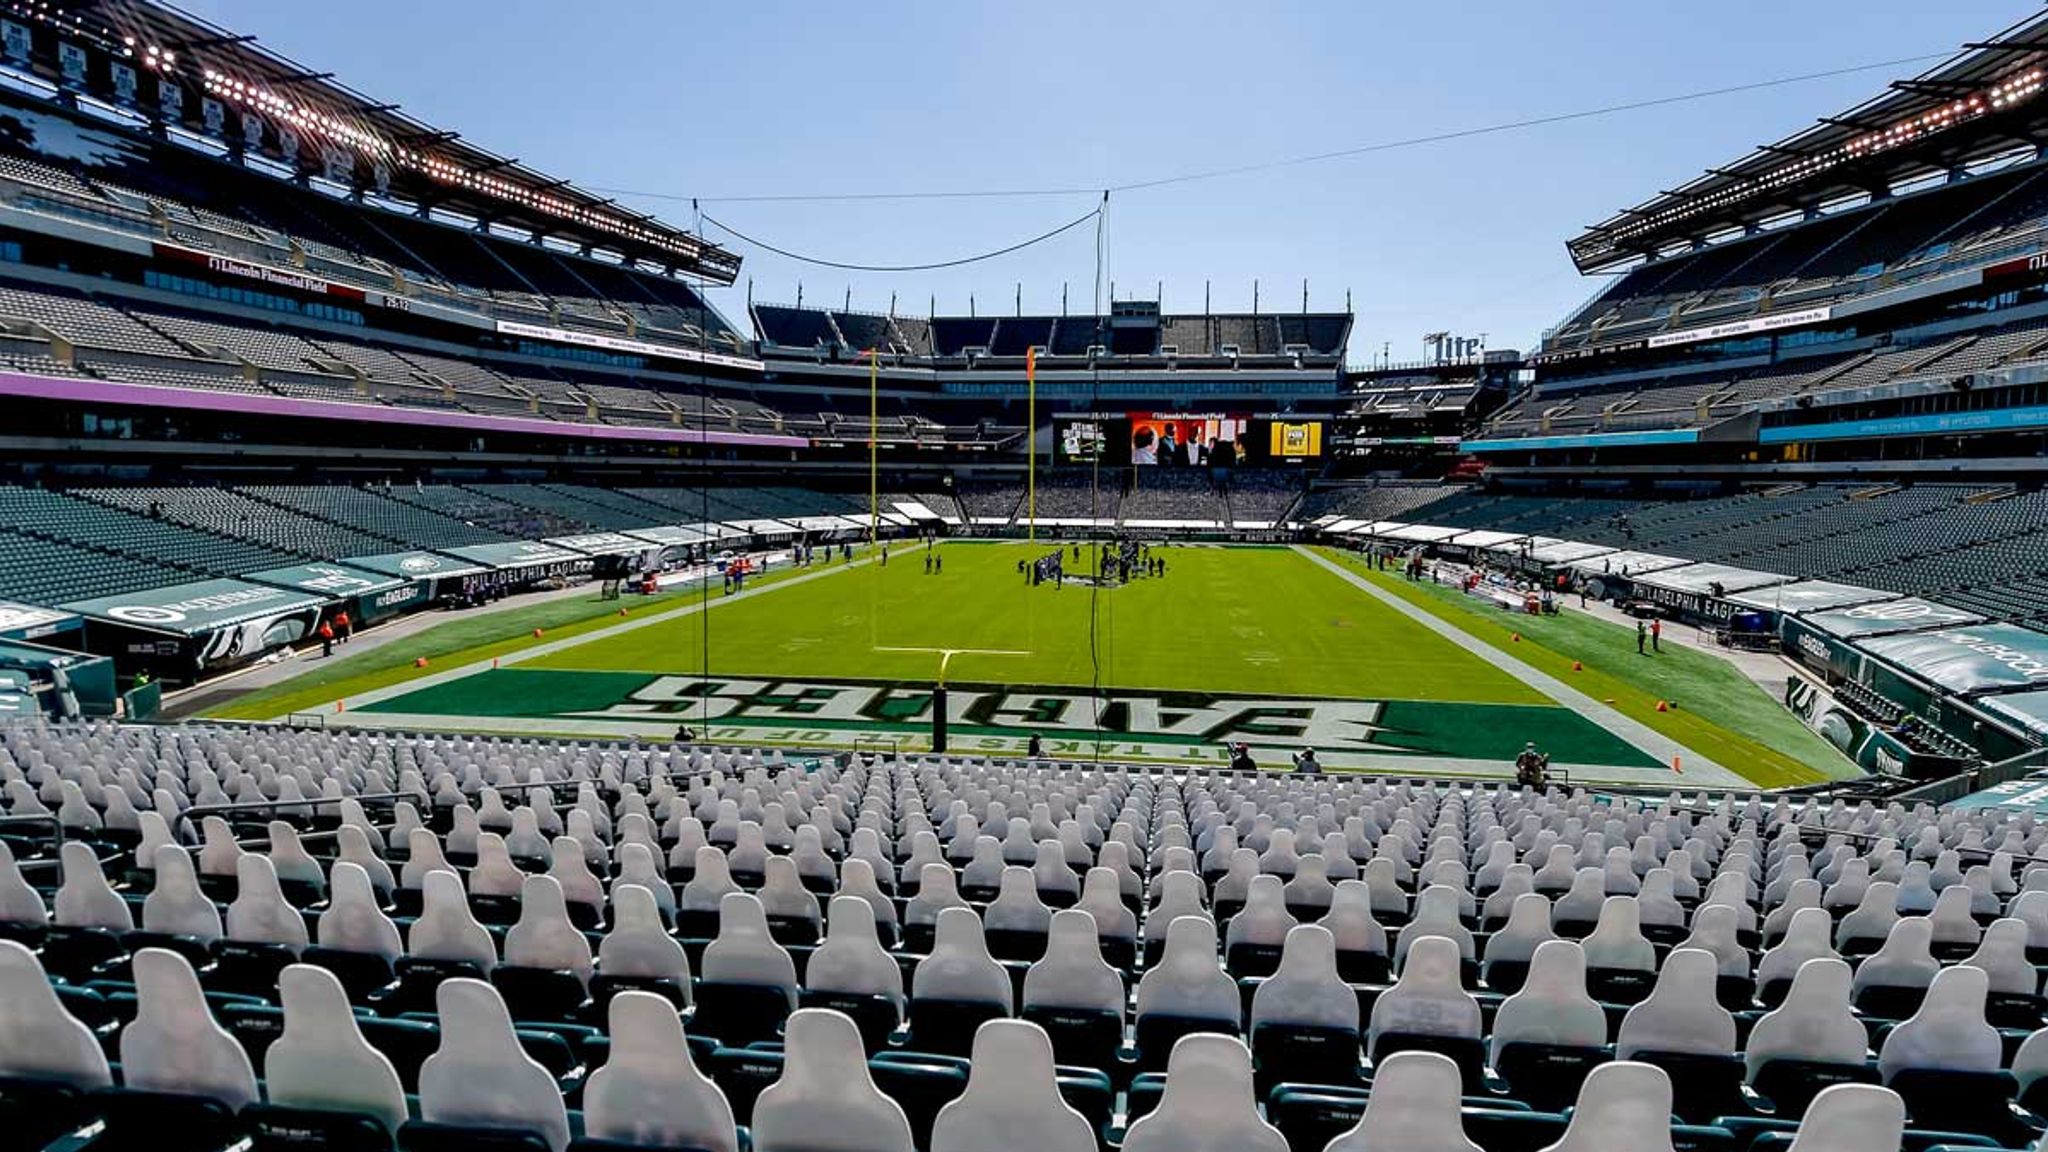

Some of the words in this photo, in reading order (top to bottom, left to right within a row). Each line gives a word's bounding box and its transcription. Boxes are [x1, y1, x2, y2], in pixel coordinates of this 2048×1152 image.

[221, 259, 261, 280] Lincoln
[261, 267, 304, 290] Financial
[305, 278, 328, 294] Field
[1434, 335, 1480, 363] Lite
[462, 564, 545, 592] PHILADELPHIA
[1632, 583, 1699, 613] PHILADELPHIA
[1705, 599, 1748, 620] EAGLE
[556, 675, 1412, 752] EAGLES
